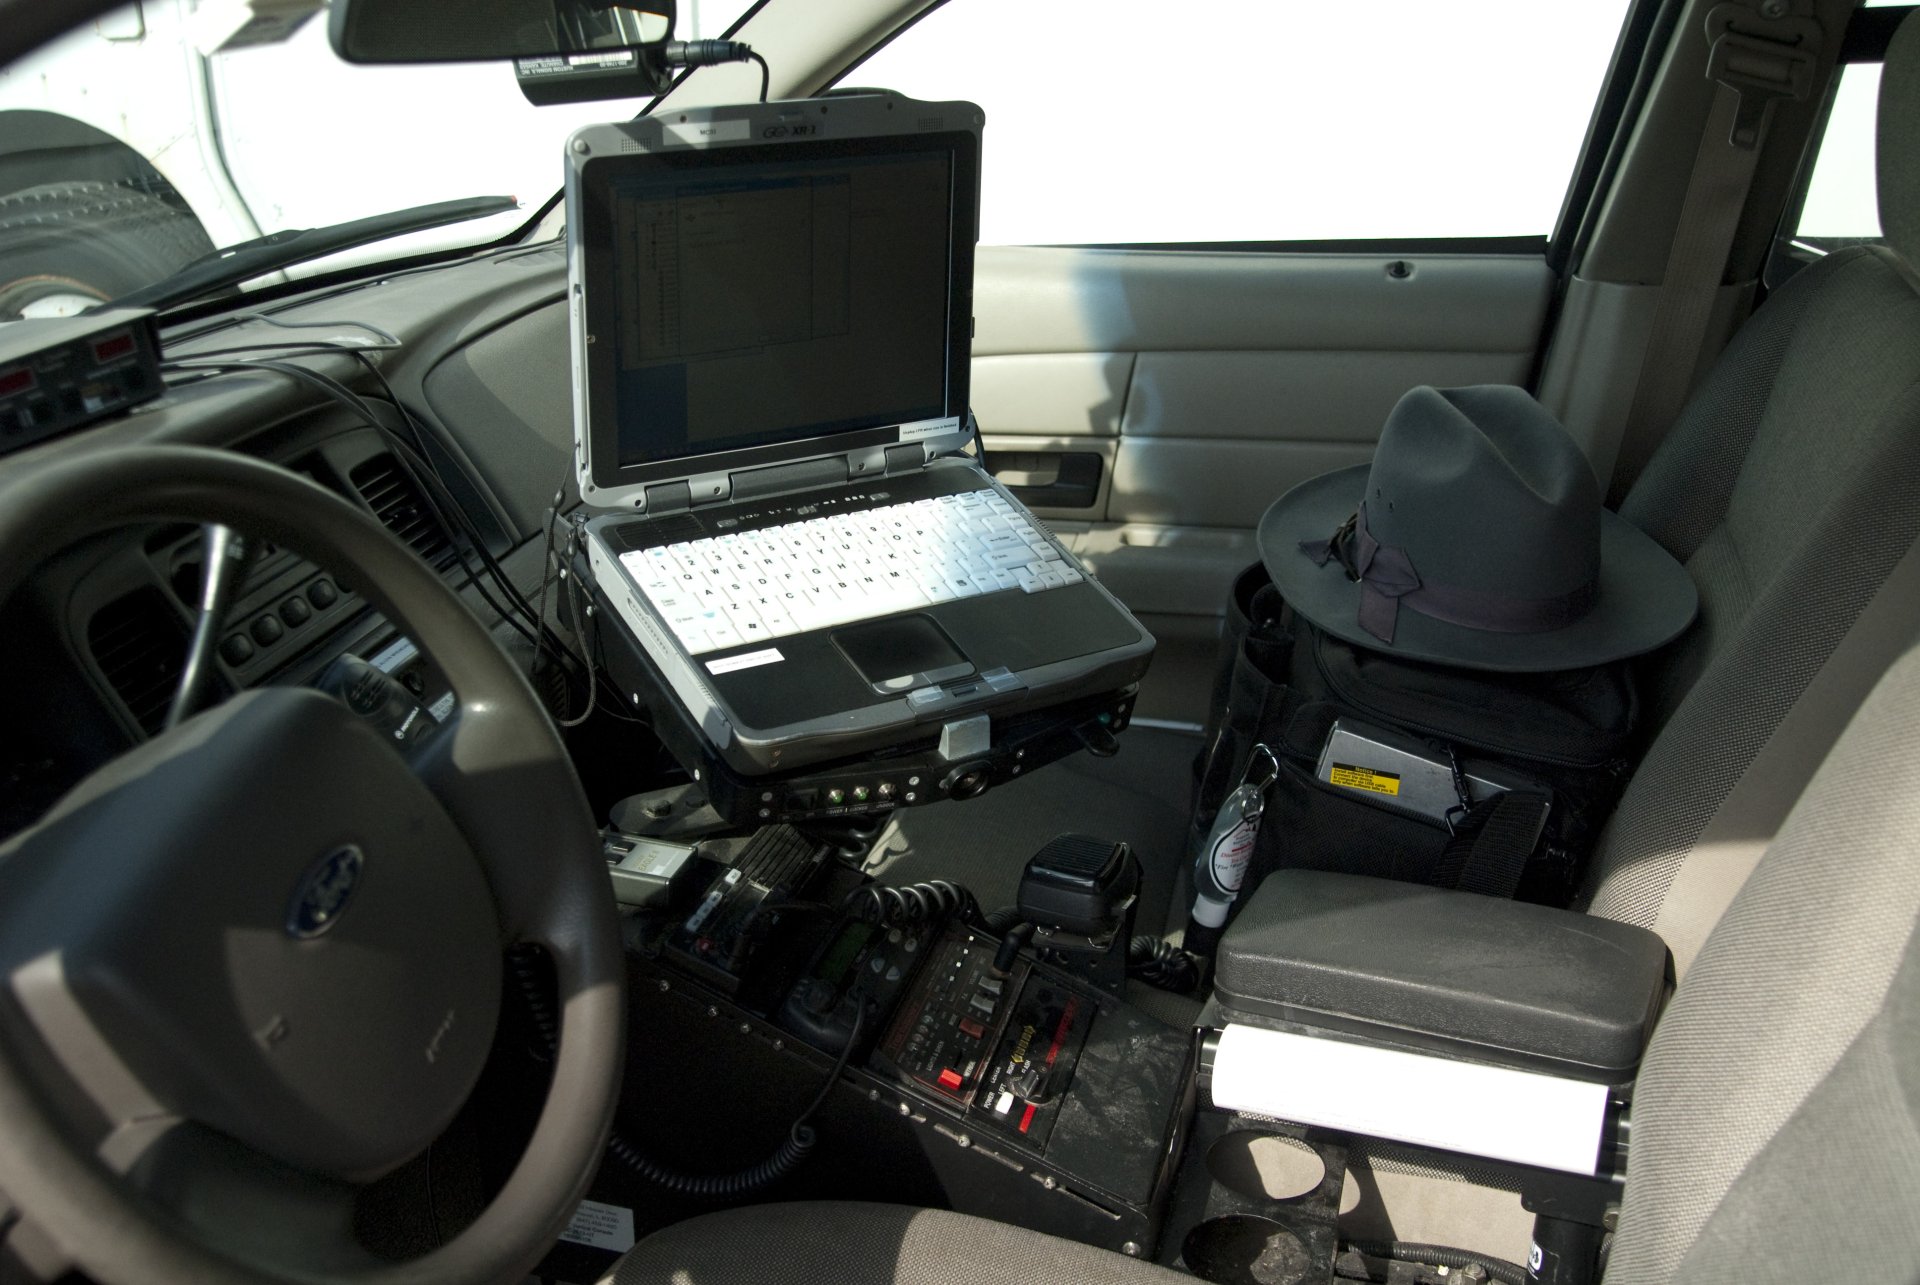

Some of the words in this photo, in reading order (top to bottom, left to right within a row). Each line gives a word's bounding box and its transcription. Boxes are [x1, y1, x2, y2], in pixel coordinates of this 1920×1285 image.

[1006, 1060, 1016, 1075] RIGHT
[998, 1082, 1007, 1095] LEFT
[984, 1091, 996, 1109] POWER
